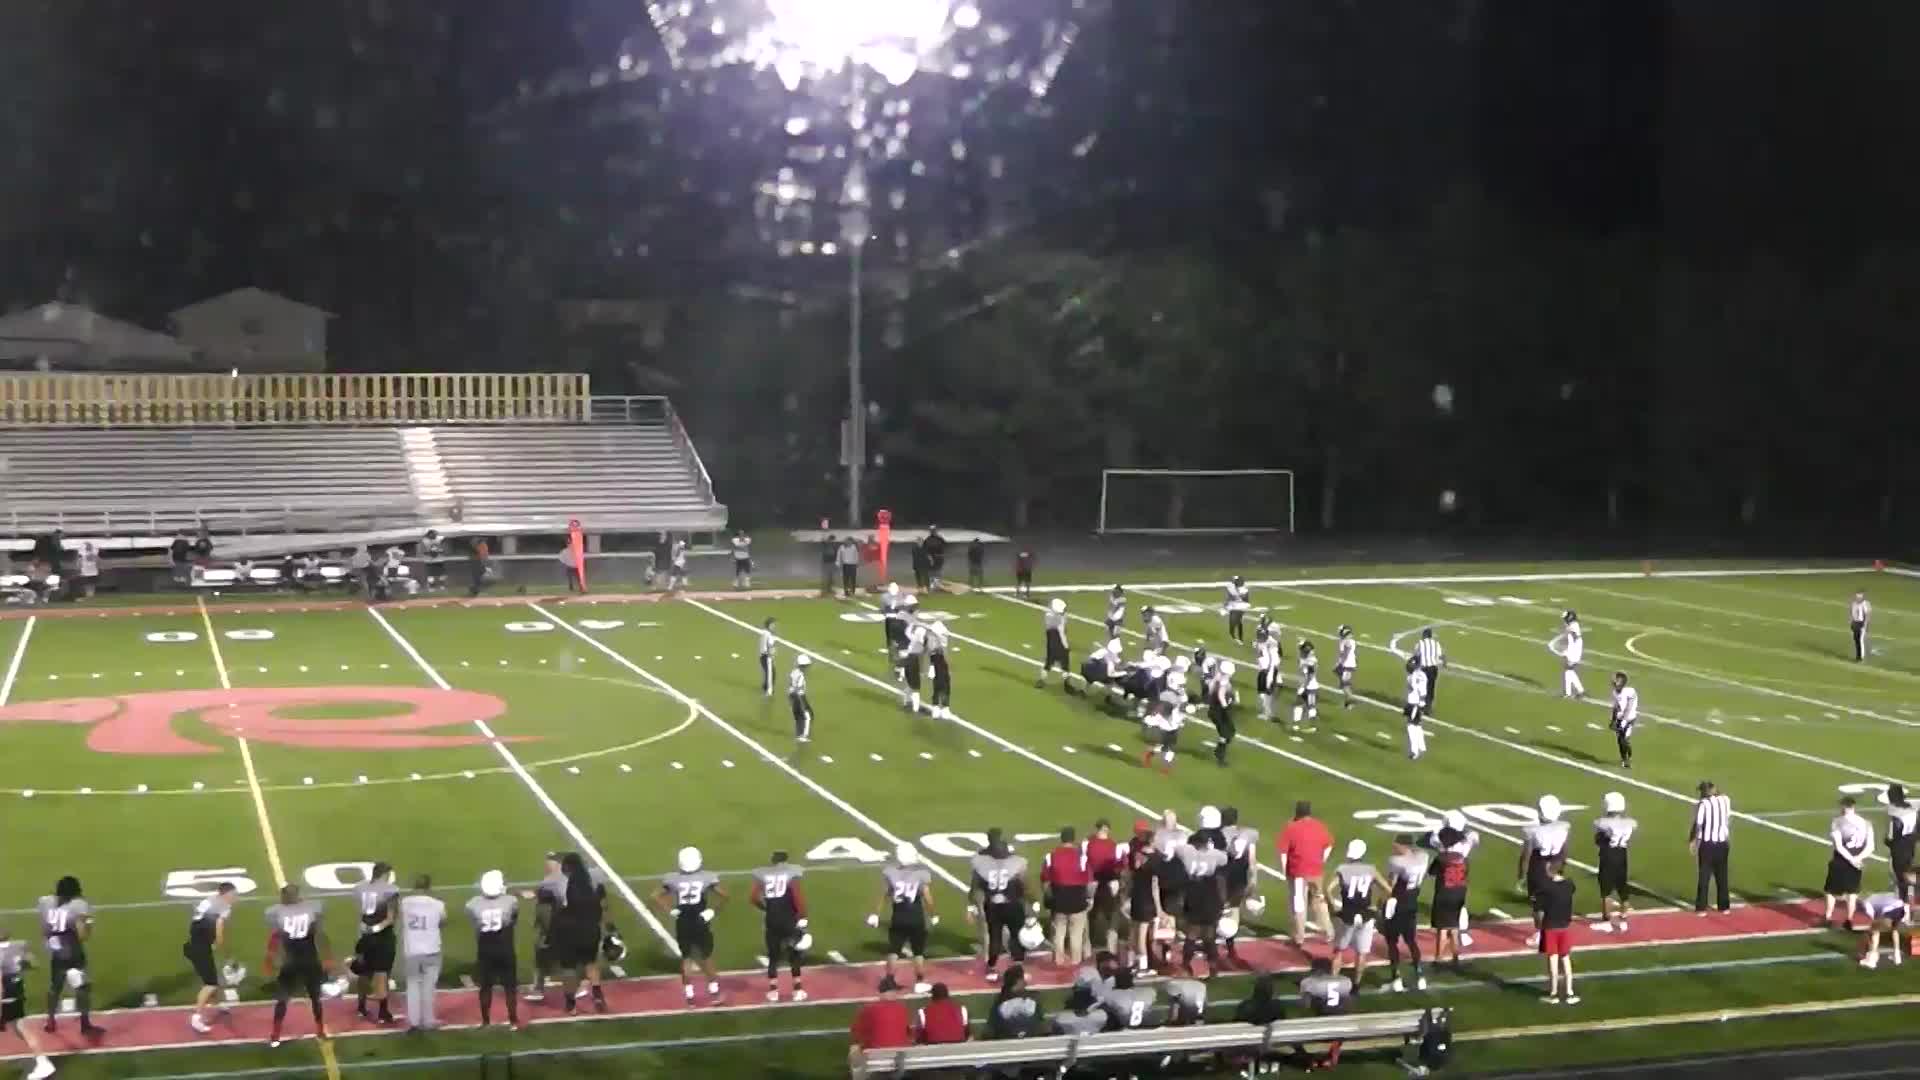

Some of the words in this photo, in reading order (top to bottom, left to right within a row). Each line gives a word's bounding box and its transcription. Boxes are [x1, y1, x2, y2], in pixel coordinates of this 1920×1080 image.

[678, 881, 703, 905] 23
[766, 874, 788, 898] 20
[894, 880, 919, 903] 24
[1347, 874, 1373, 898] 14
[283, 913, 310, 939] 40
[1326, 981, 1341, 1007] 5
[1129, 1000, 1145, 1027] 8
